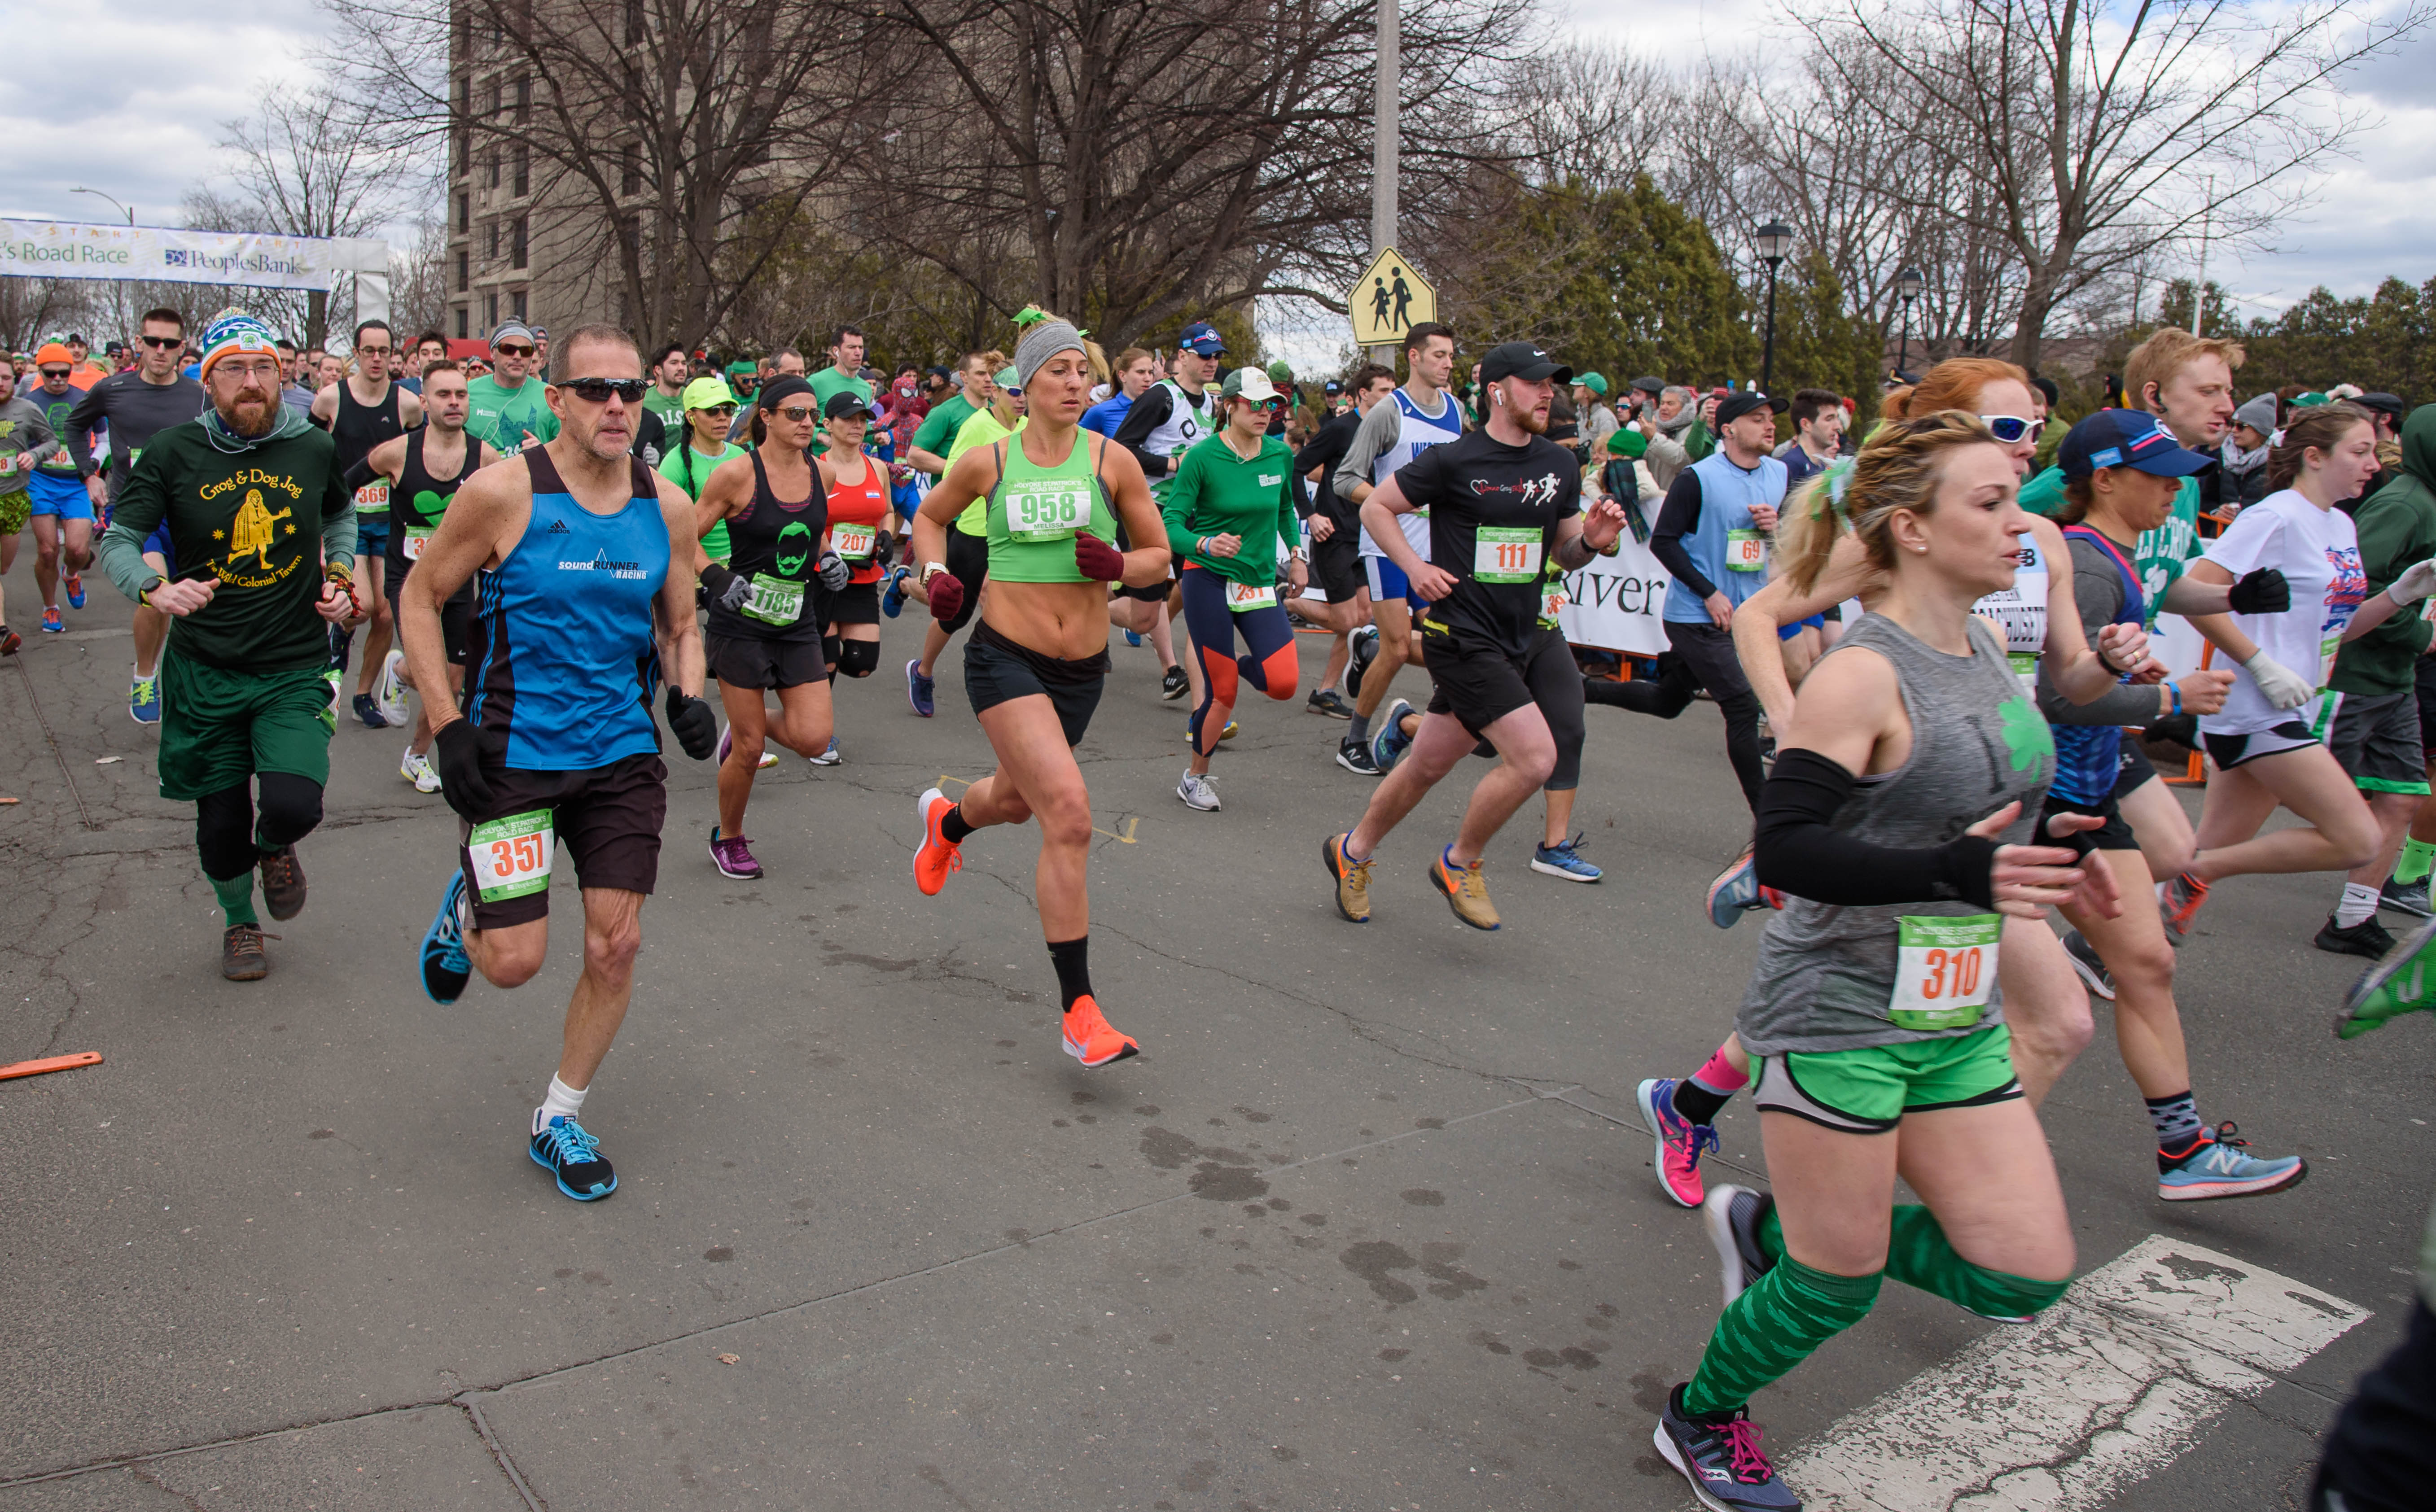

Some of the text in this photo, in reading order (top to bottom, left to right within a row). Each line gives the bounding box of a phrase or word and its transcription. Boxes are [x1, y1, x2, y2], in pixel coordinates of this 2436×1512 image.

[23, 242, 74, 262] Road
[82, 245, 129, 264] Race
[191, 250, 302, 275] PeoplesBank
[200, 469, 303, 500] Grog & Dog Jog
[359, 487, 387, 503] 369
[1021, 493, 1076, 524] 958
[841, 533, 867, 551] 207
[1742, 540, 1760, 560] 69
[1495, 543, 1527, 568] 111
[218, 567, 238, 584] Wild
[237, 572, 277, 587] Colonial
[276, 555, 302, 578] Tavern
[616, 571, 647, 580] RACING
[754, 589, 797, 615] 1185
[1561, 571, 1665, 616] iver
[479, 824, 509, 836] HOLYOKE
[497, 829, 517, 839] ROAD
[518, 825, 535, 835] RACE
[492, 832, 543, 877] 357
[1922, 947, 1981, 1000] 310
